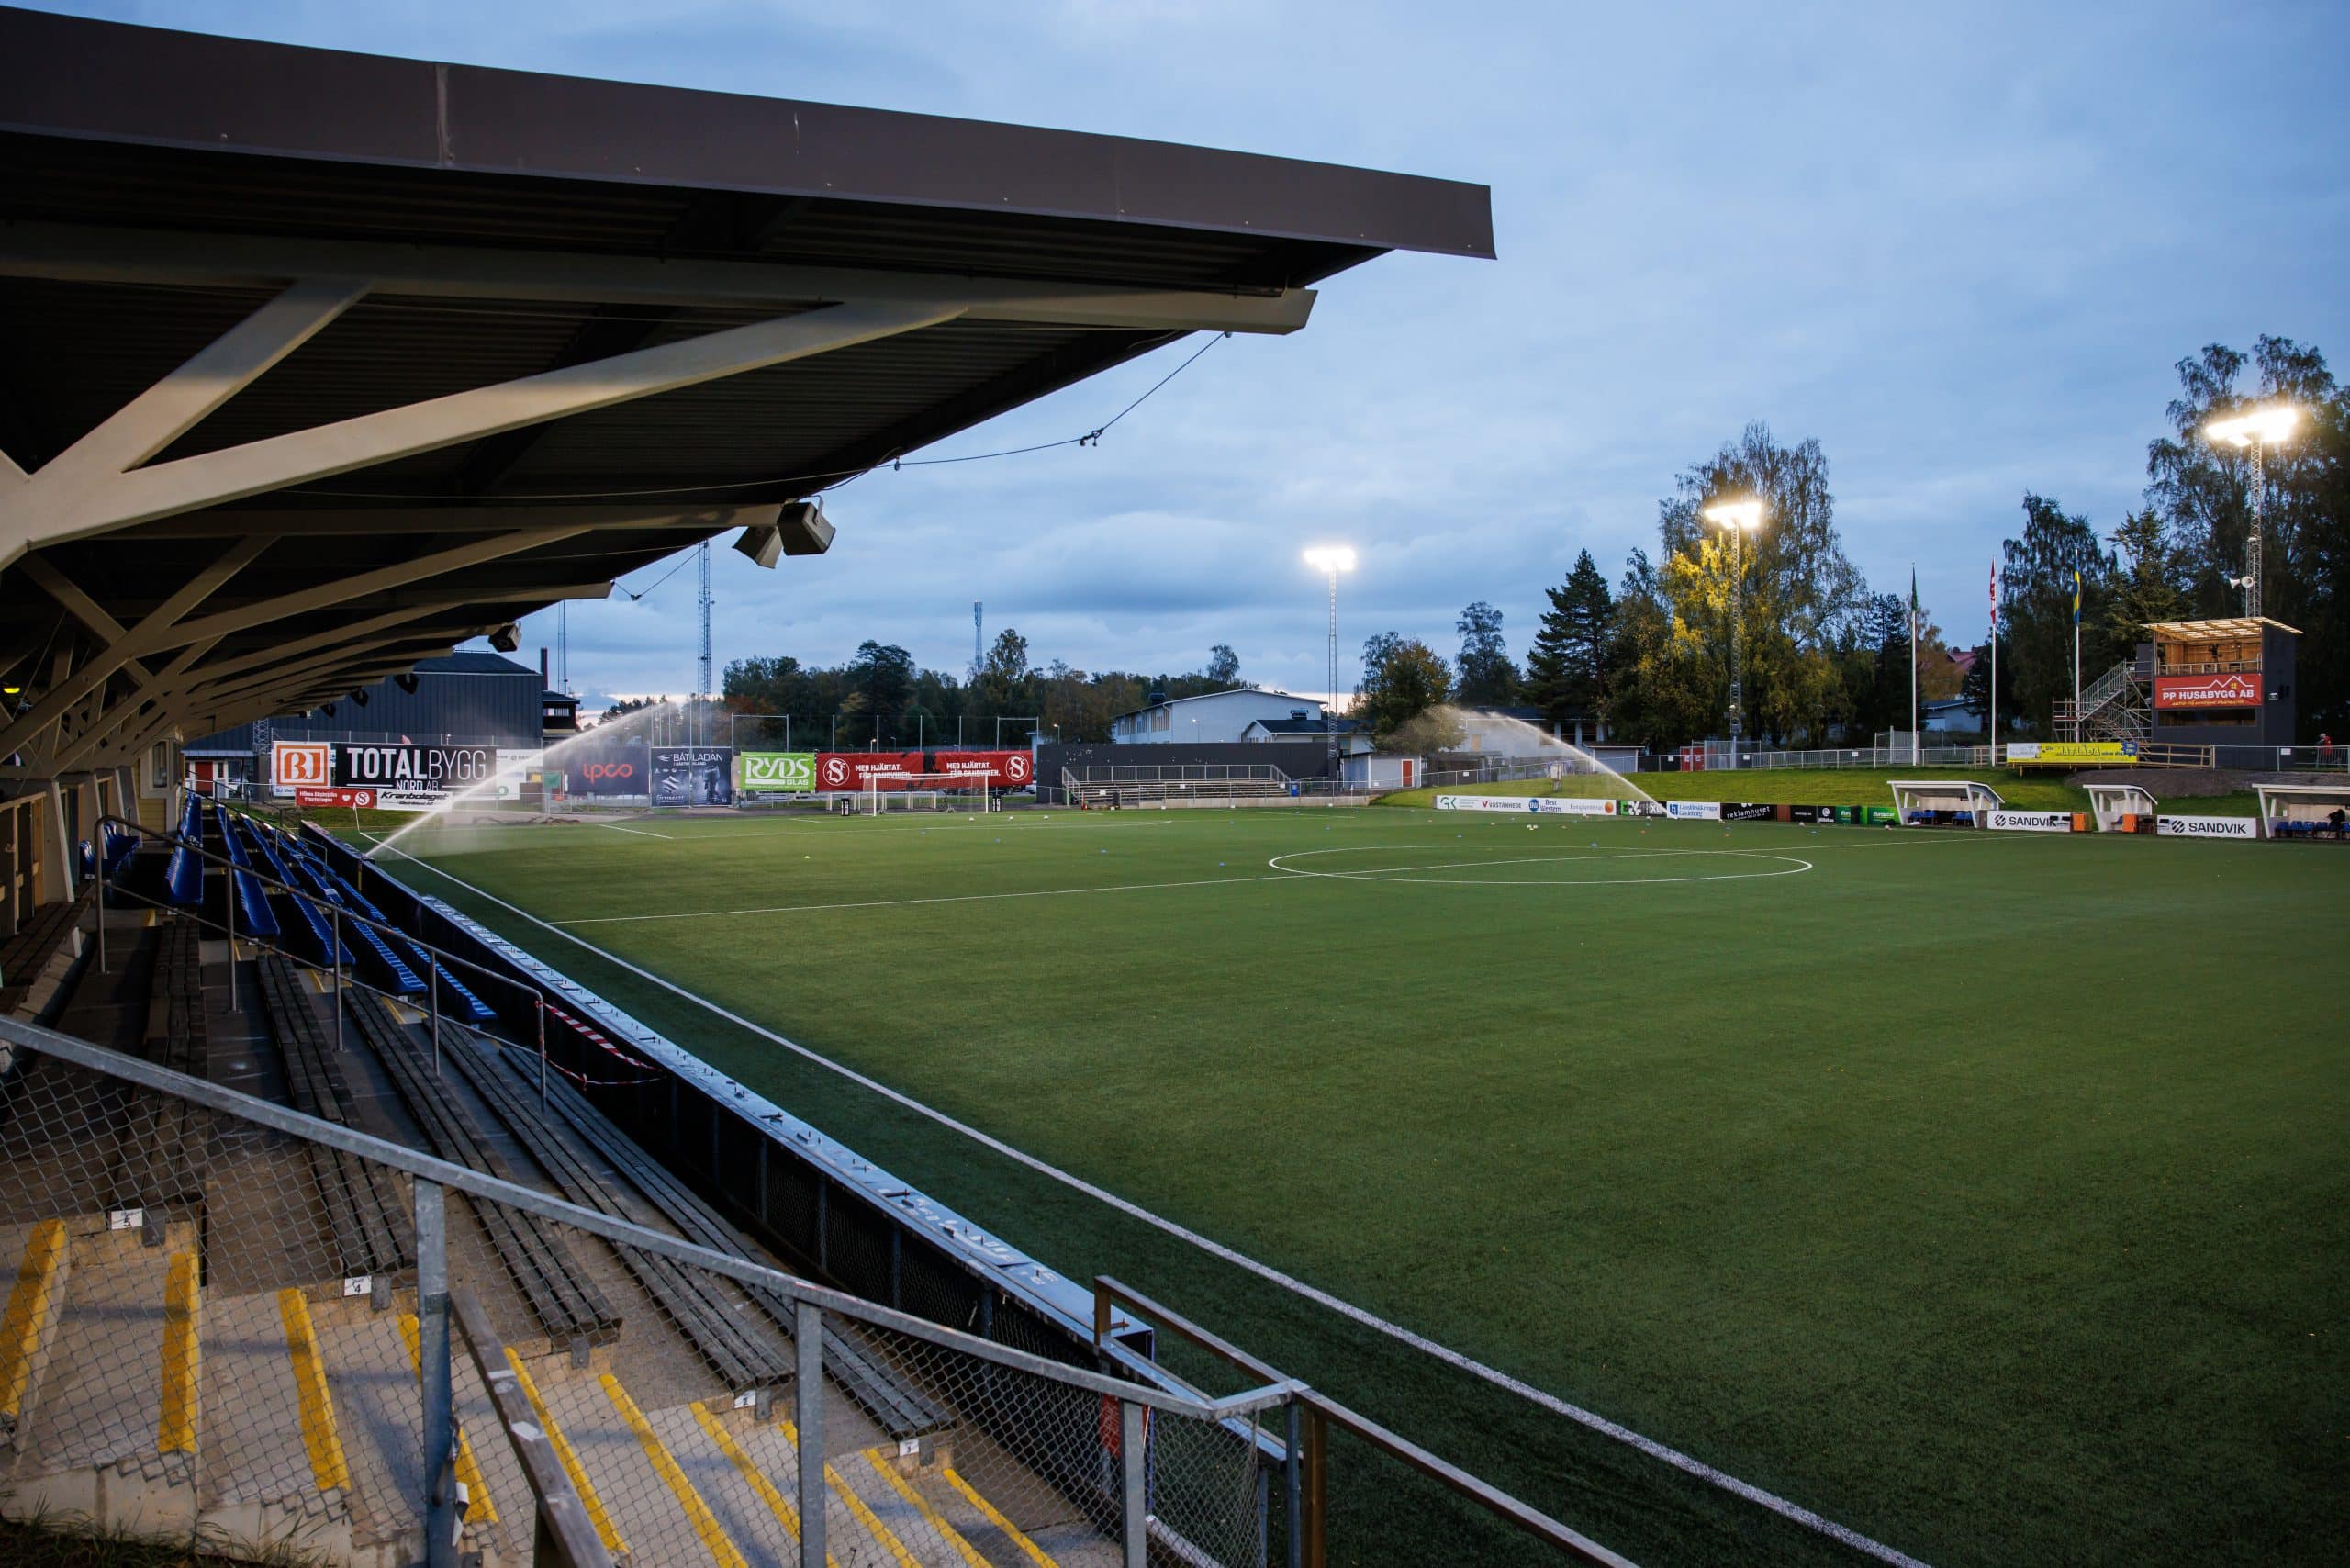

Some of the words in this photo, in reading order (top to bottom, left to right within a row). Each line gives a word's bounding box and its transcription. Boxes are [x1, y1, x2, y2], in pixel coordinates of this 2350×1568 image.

[2162, 691, 2177, 700] PP
[2179, 689, 2236, 700] HUS&BYGG
[2239, 689, 2255, 699] AB
[284, 751, 321, 780] BJ
[745, 757, 810, 779] RYDS
[856, 764, 869, 772] MED
[870, 762, 903, 772] HJÄRTAT.
[946, 762, 961, 770] MED
[961, 760, 992, 769] HJÄRTAT.
[396, 779, 423, 790] NORD
[426, 780, 439, 791] AB
[1726, 805, 1771, 819] reklamhuset
[2188, 822, 2247, 834] SANDVIK
[124, 1217, 131, 1227] 5
[354, 1283, 361, 1293] 4
